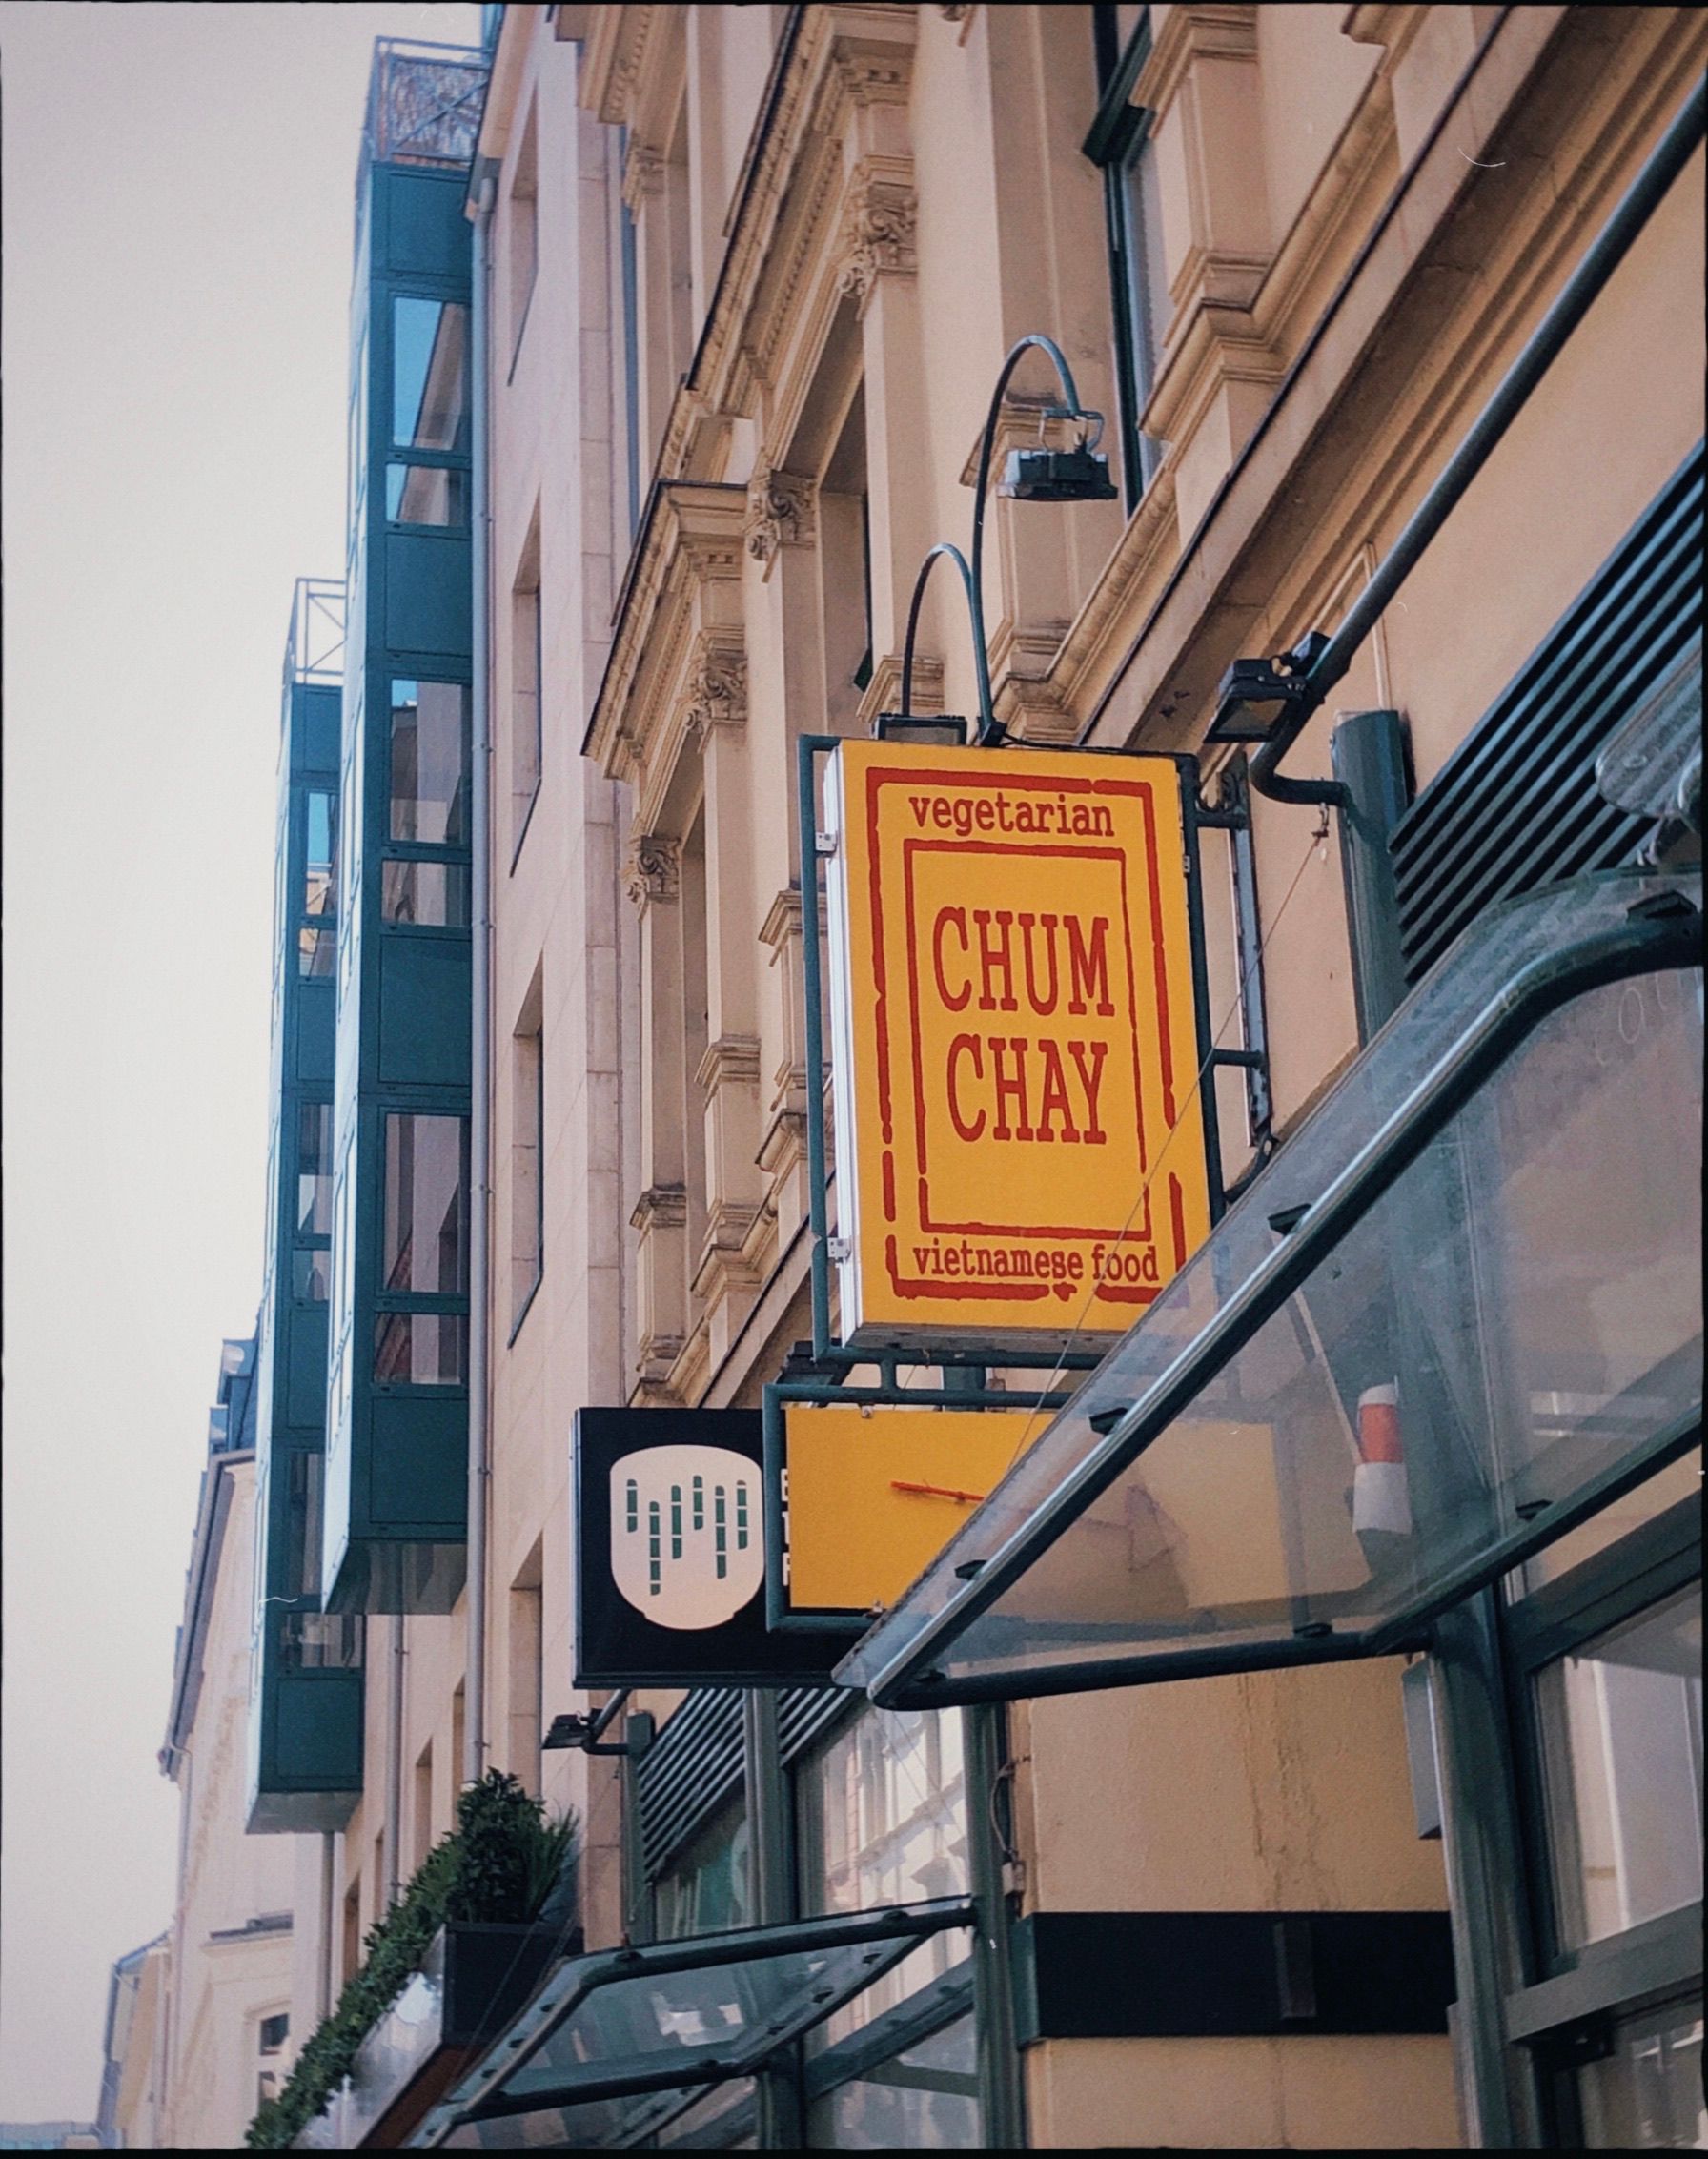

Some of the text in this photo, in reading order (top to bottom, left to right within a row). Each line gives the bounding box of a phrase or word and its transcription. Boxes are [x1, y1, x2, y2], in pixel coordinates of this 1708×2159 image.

[909, 792, 1114, 837] vegetarian
[933, 906, 1115, 1017] CHUM
[946, 1033, 1108, 1144] CHAY
[913, 1238, 1158, 1281] vietnamese food
